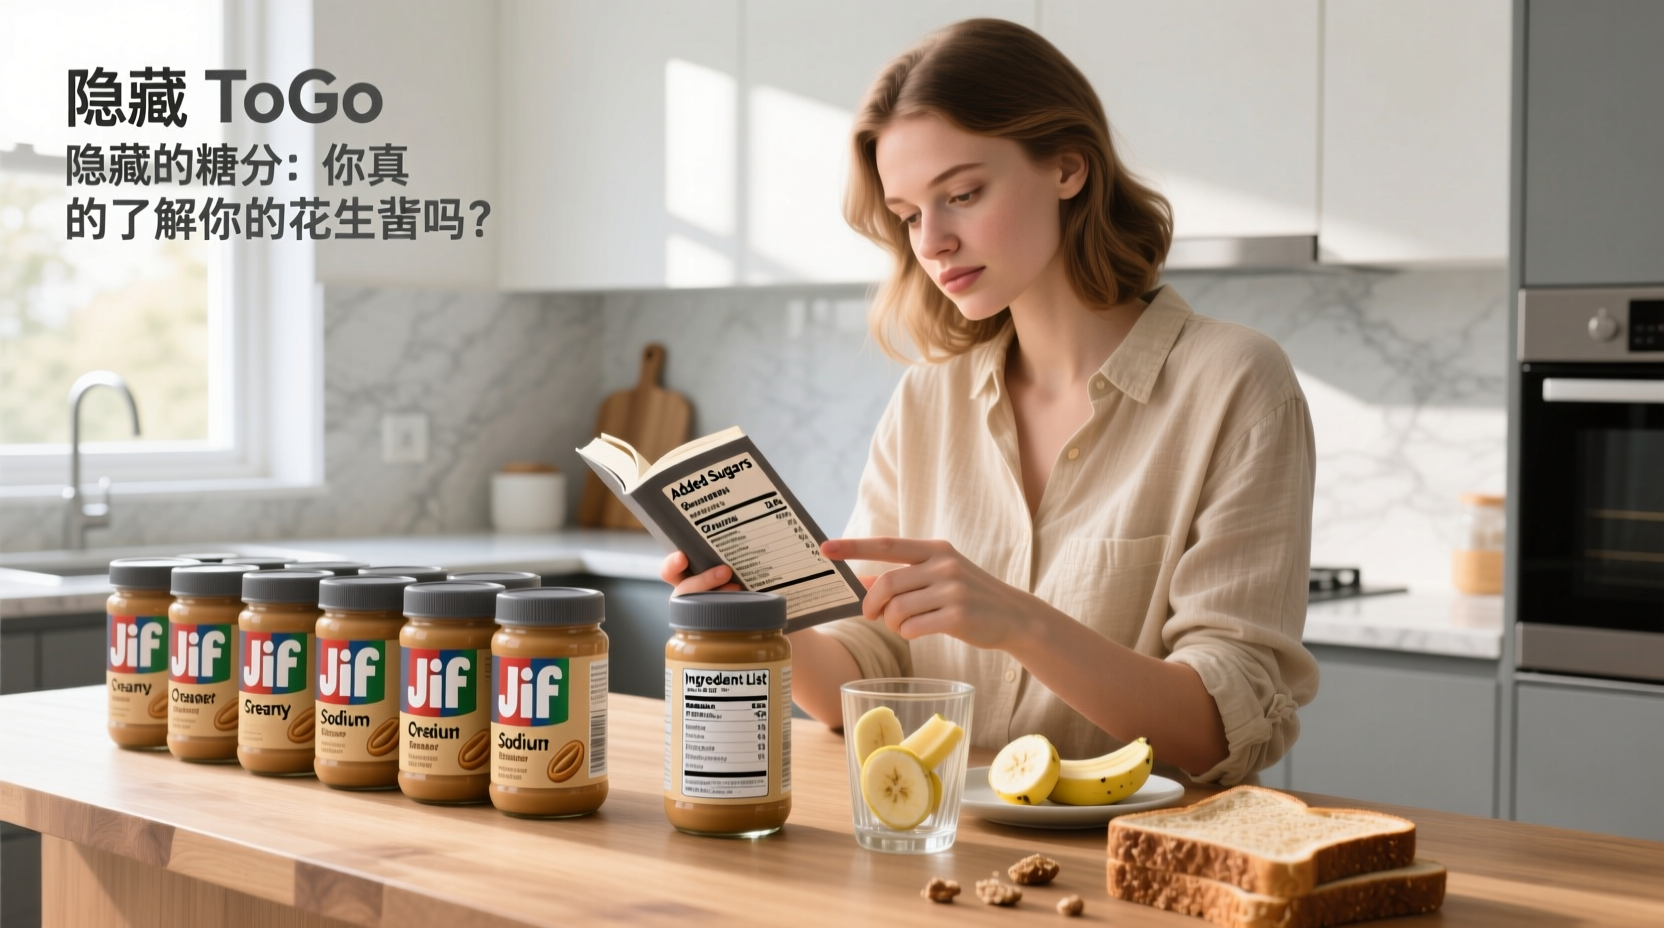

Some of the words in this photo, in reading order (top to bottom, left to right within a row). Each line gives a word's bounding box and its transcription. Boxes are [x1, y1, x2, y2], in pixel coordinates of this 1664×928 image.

[707, 458, 753, 482] Sugars
[110, 622, 163, 668] Jif
[171, 630, 226, 677] Jif
[243, 639, 302, 688] Jif
[319, 647, 380, 698] Jif
[407, 656, 471, 709] Jif
[498, 665, 563, 719] Jif
[321, 708, 370, 727] Sodium
